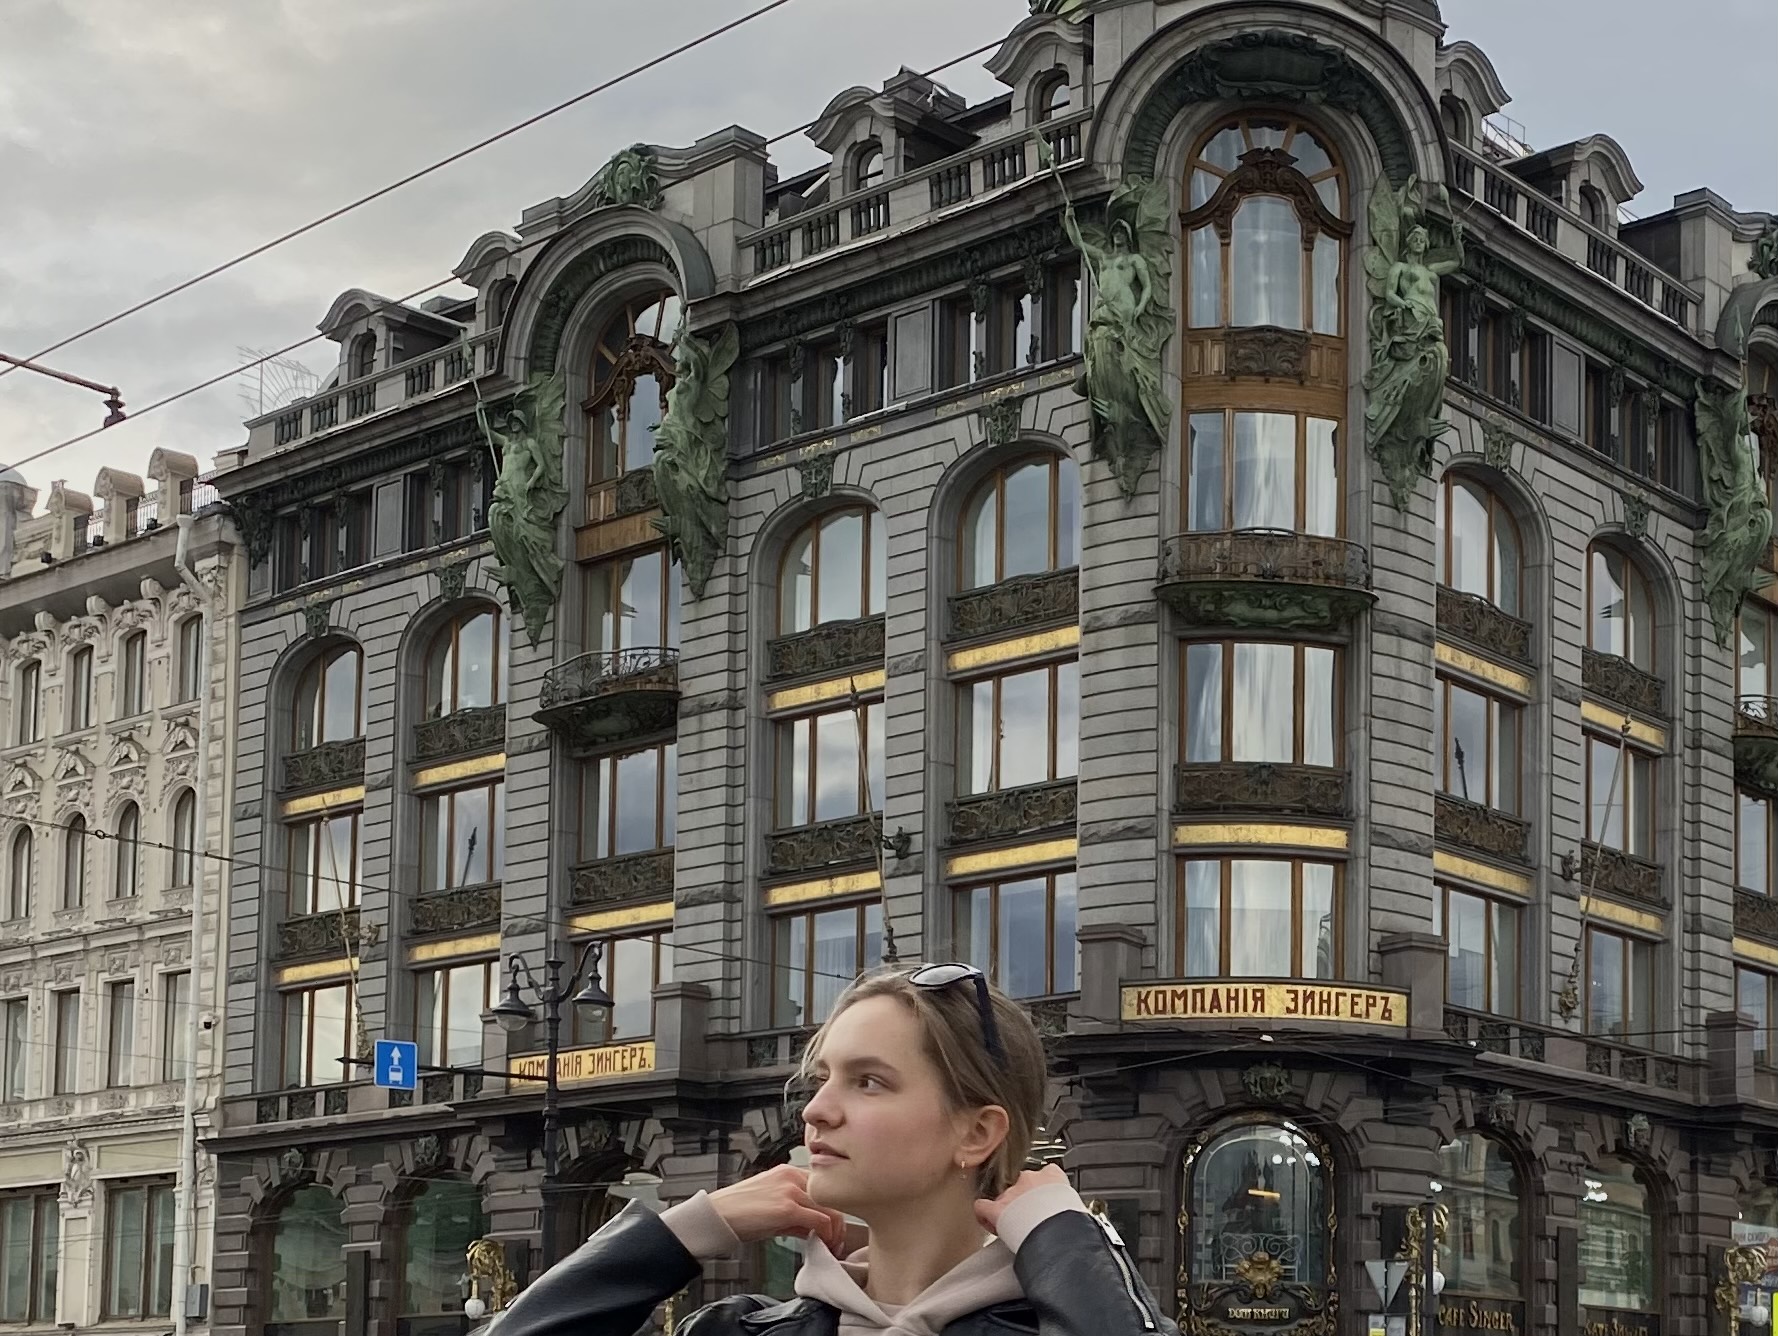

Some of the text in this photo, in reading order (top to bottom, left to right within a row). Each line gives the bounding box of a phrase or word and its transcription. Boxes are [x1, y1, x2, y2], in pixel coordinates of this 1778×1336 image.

[1136, 988, 1393, 1022] КОМПАНІЯ ЗИНГЕРЪ
[519, 1054, 582, 1083] КОМАНІЯ
